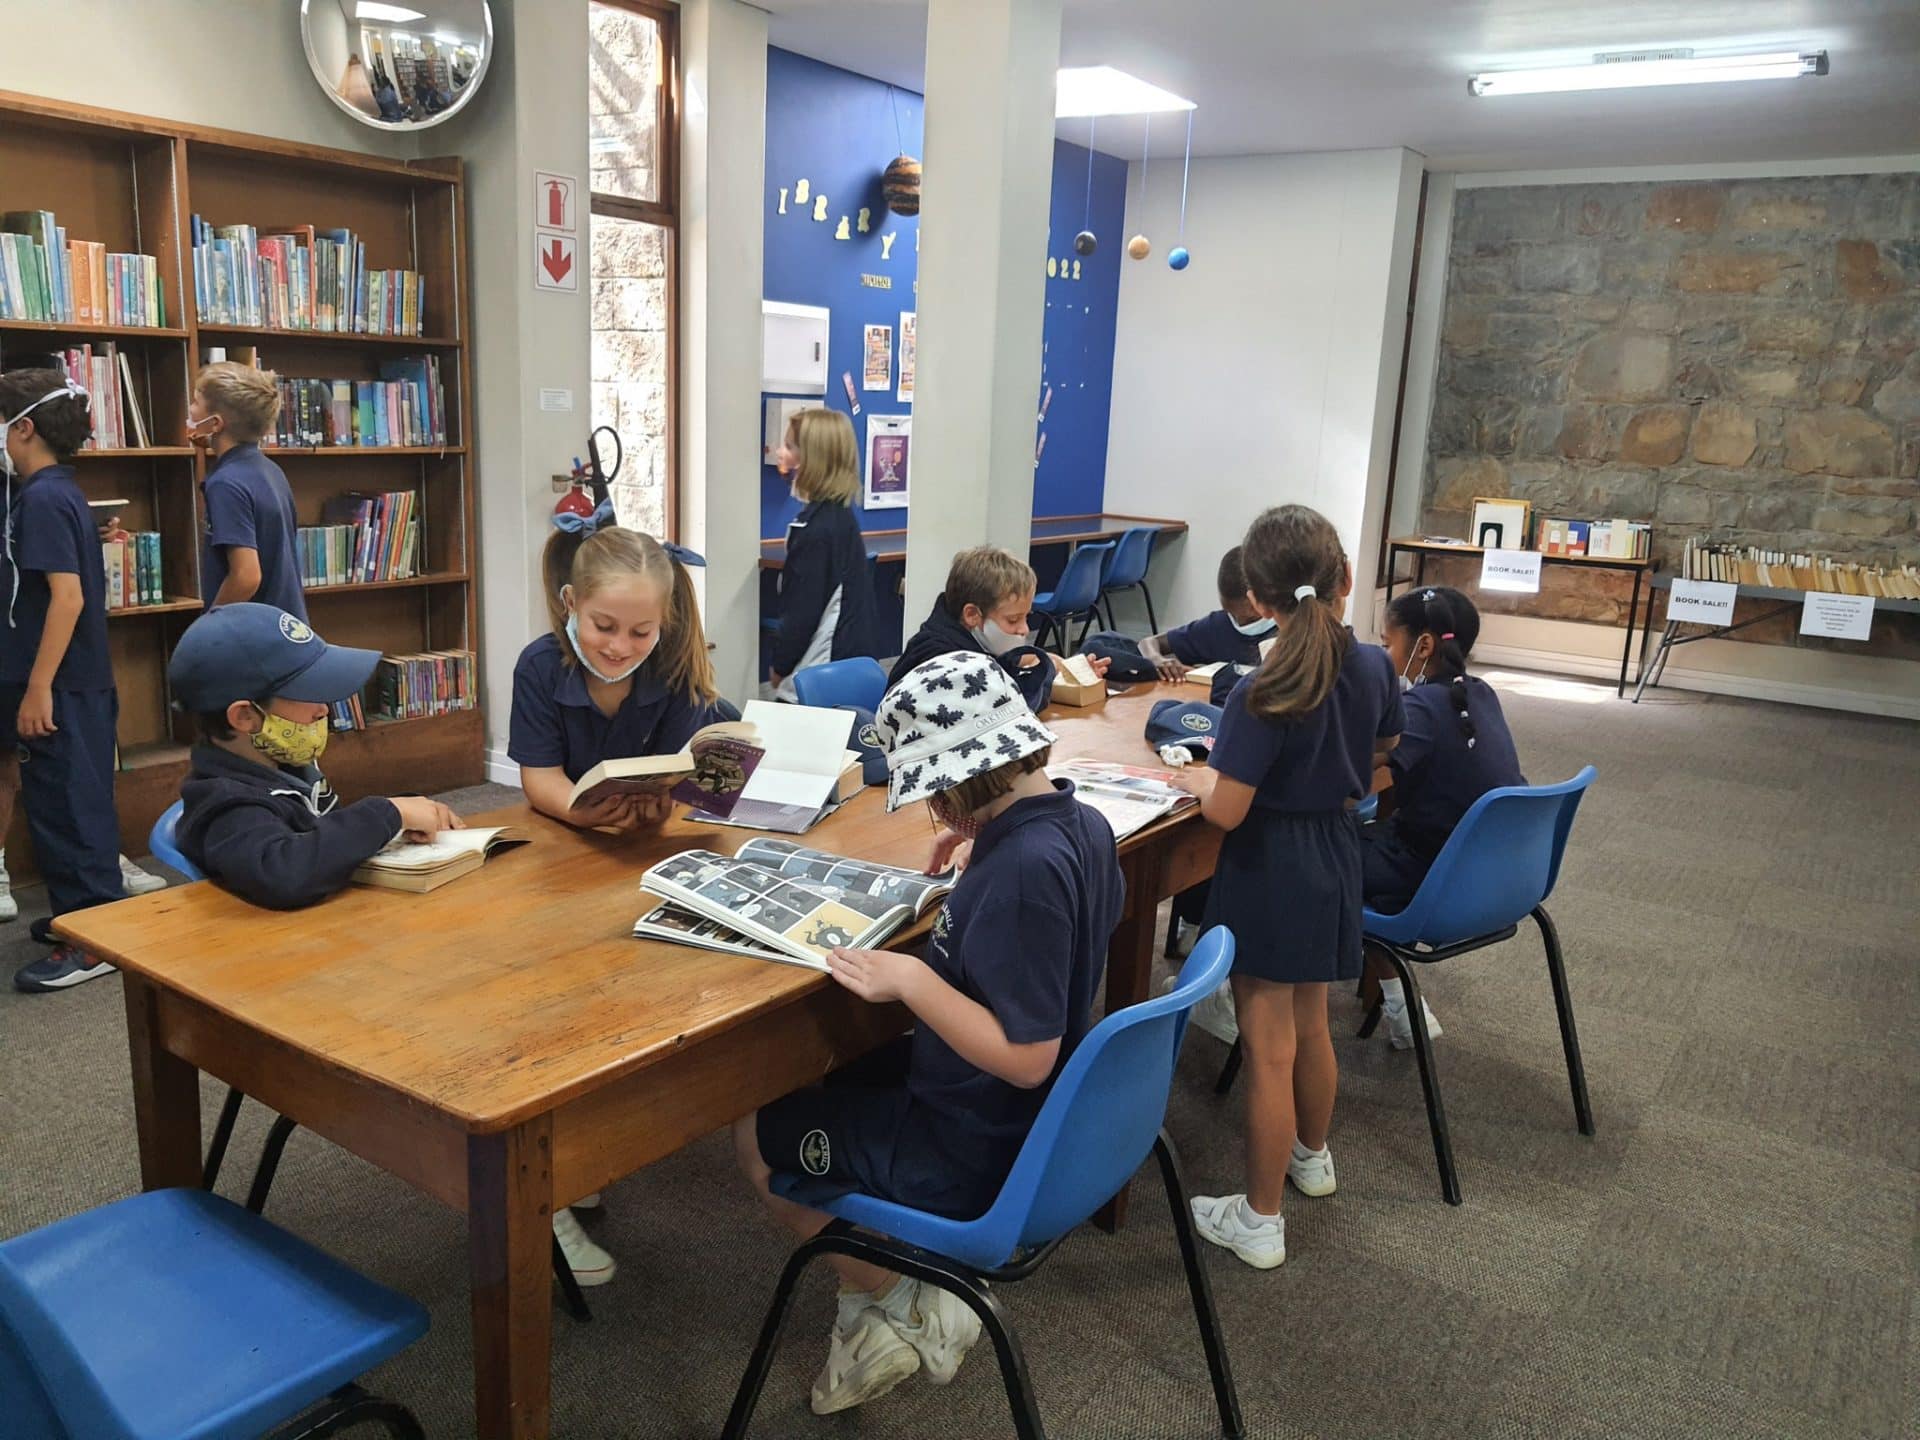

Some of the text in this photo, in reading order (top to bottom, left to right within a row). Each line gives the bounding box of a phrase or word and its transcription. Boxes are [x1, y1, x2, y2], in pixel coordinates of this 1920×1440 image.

[778, 178, 897, 260] IBRARY
[1047, 256, 1081, 280] 022
[1487, 565, 1535, 576] BOOK SALE!!
[1675, 596, 1728, 608] BOOK SALE!!
